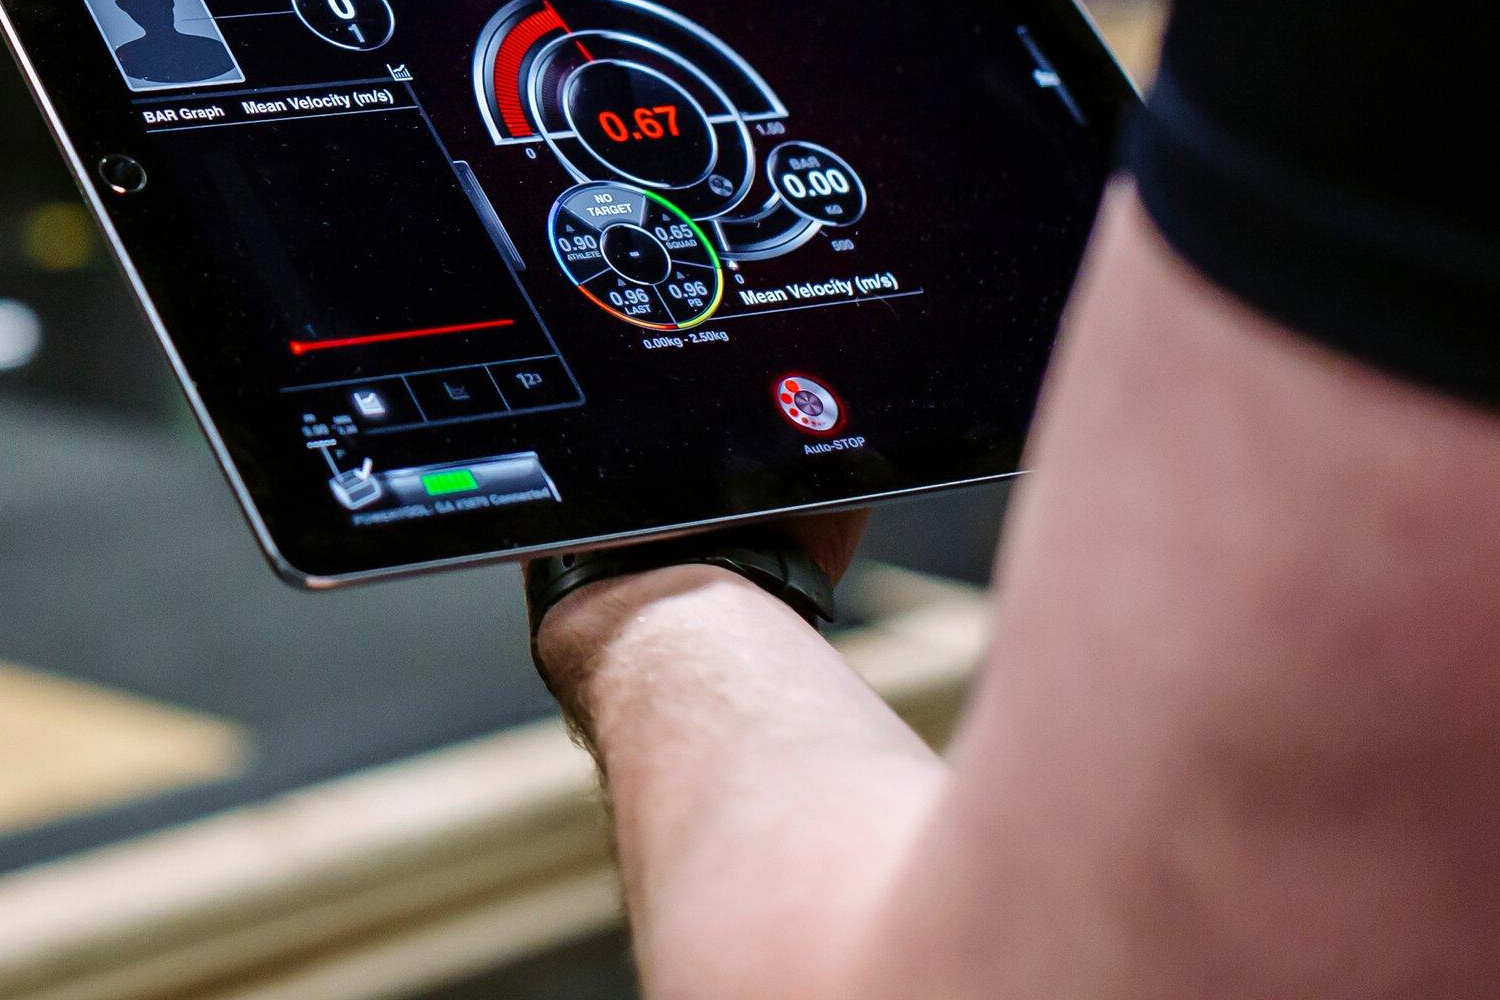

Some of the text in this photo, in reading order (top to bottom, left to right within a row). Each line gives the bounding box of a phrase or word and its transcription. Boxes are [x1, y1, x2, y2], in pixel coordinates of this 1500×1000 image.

[348, 24, 365, 42] 1
[241, 89, 394, 114] Mean Velocity (m/s)
[143, 105, 225, 124] BAR Graph
[599, 105, 680, 142] 0.67
[525, 148, 536, 159] 0
[782, 168, 850, 198] 0.00
[594, 193, 613, 205] NO
[586, 203, 633, 217] TARGET
[655, 224, 693, 241] 0.65
[558, 234, 597, 252] 0.90
[666, 239, 697, 249] SQUAD
[567, 250, 601, 261] ATHLETE
[734, 273, 745, 284] 0
[609, 288, 649, 306] 0.96
[668, 281, 708, 299] 0.96
[739, 272, 898, 306] Mean Velocity (m/s)
[625, 304, 651, 316] LAST
[687, 298, 703, 308] PB
[643, 335, 683, 350] 0.00kg
[689, 331, 729, 343] 2.50kg
[515, 372, 543, 390] 123
[804, 436, 866, 455] Auto-STOP
